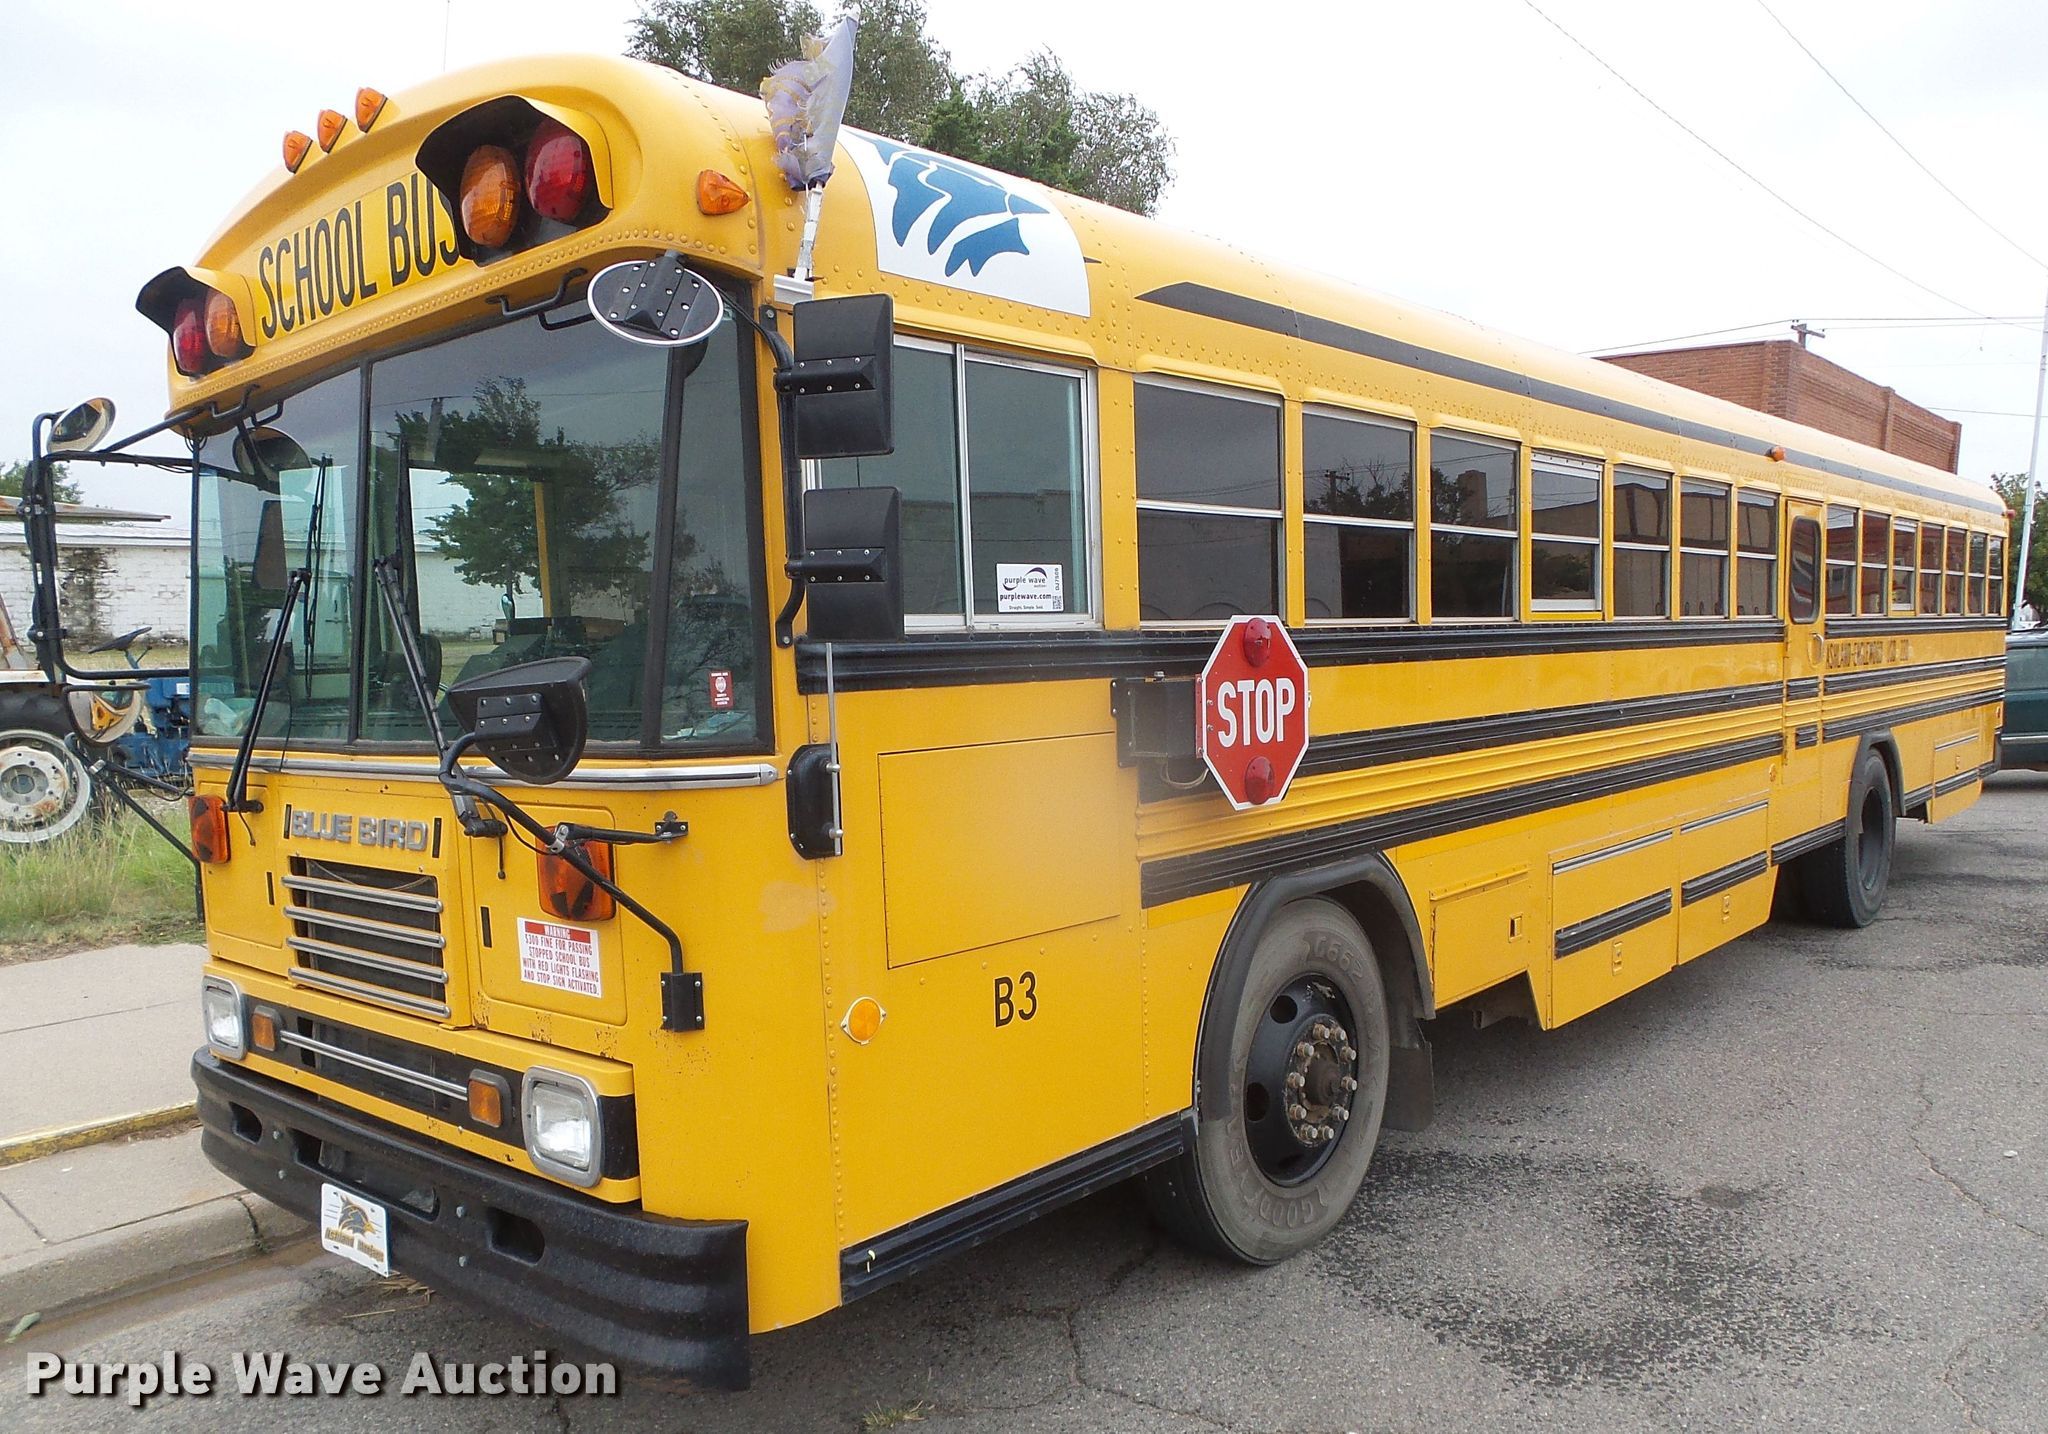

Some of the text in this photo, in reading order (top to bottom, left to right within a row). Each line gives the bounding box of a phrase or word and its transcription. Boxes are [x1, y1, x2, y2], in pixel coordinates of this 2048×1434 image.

[259, 201, 378, 339] SCHOOL
[1004, 576, 1026, 585] purple
[999, 592, 1052, 601] purplewave.com
[1217, 677, 1296, 748] STOP
[291, 810, 429, 851] BLUE BIRD
[544, 925, 571, 940] WARNING
[541, 936, 553, 948] FINE
[555, 939, 566, 951] FOR
[568, 941, 593, 955] PASSING
[528, 946, 590, 968] STOPPED SCHOOL BUS
[522, 957, 599, 982] WITH RED LIGHTS FLASHING
[524, 969, 535, 981] AND
[536, 972, 550, 983] STOP
[552, 975, 566, 987] SIGN
[994, 971, 1037, 1028] B3
